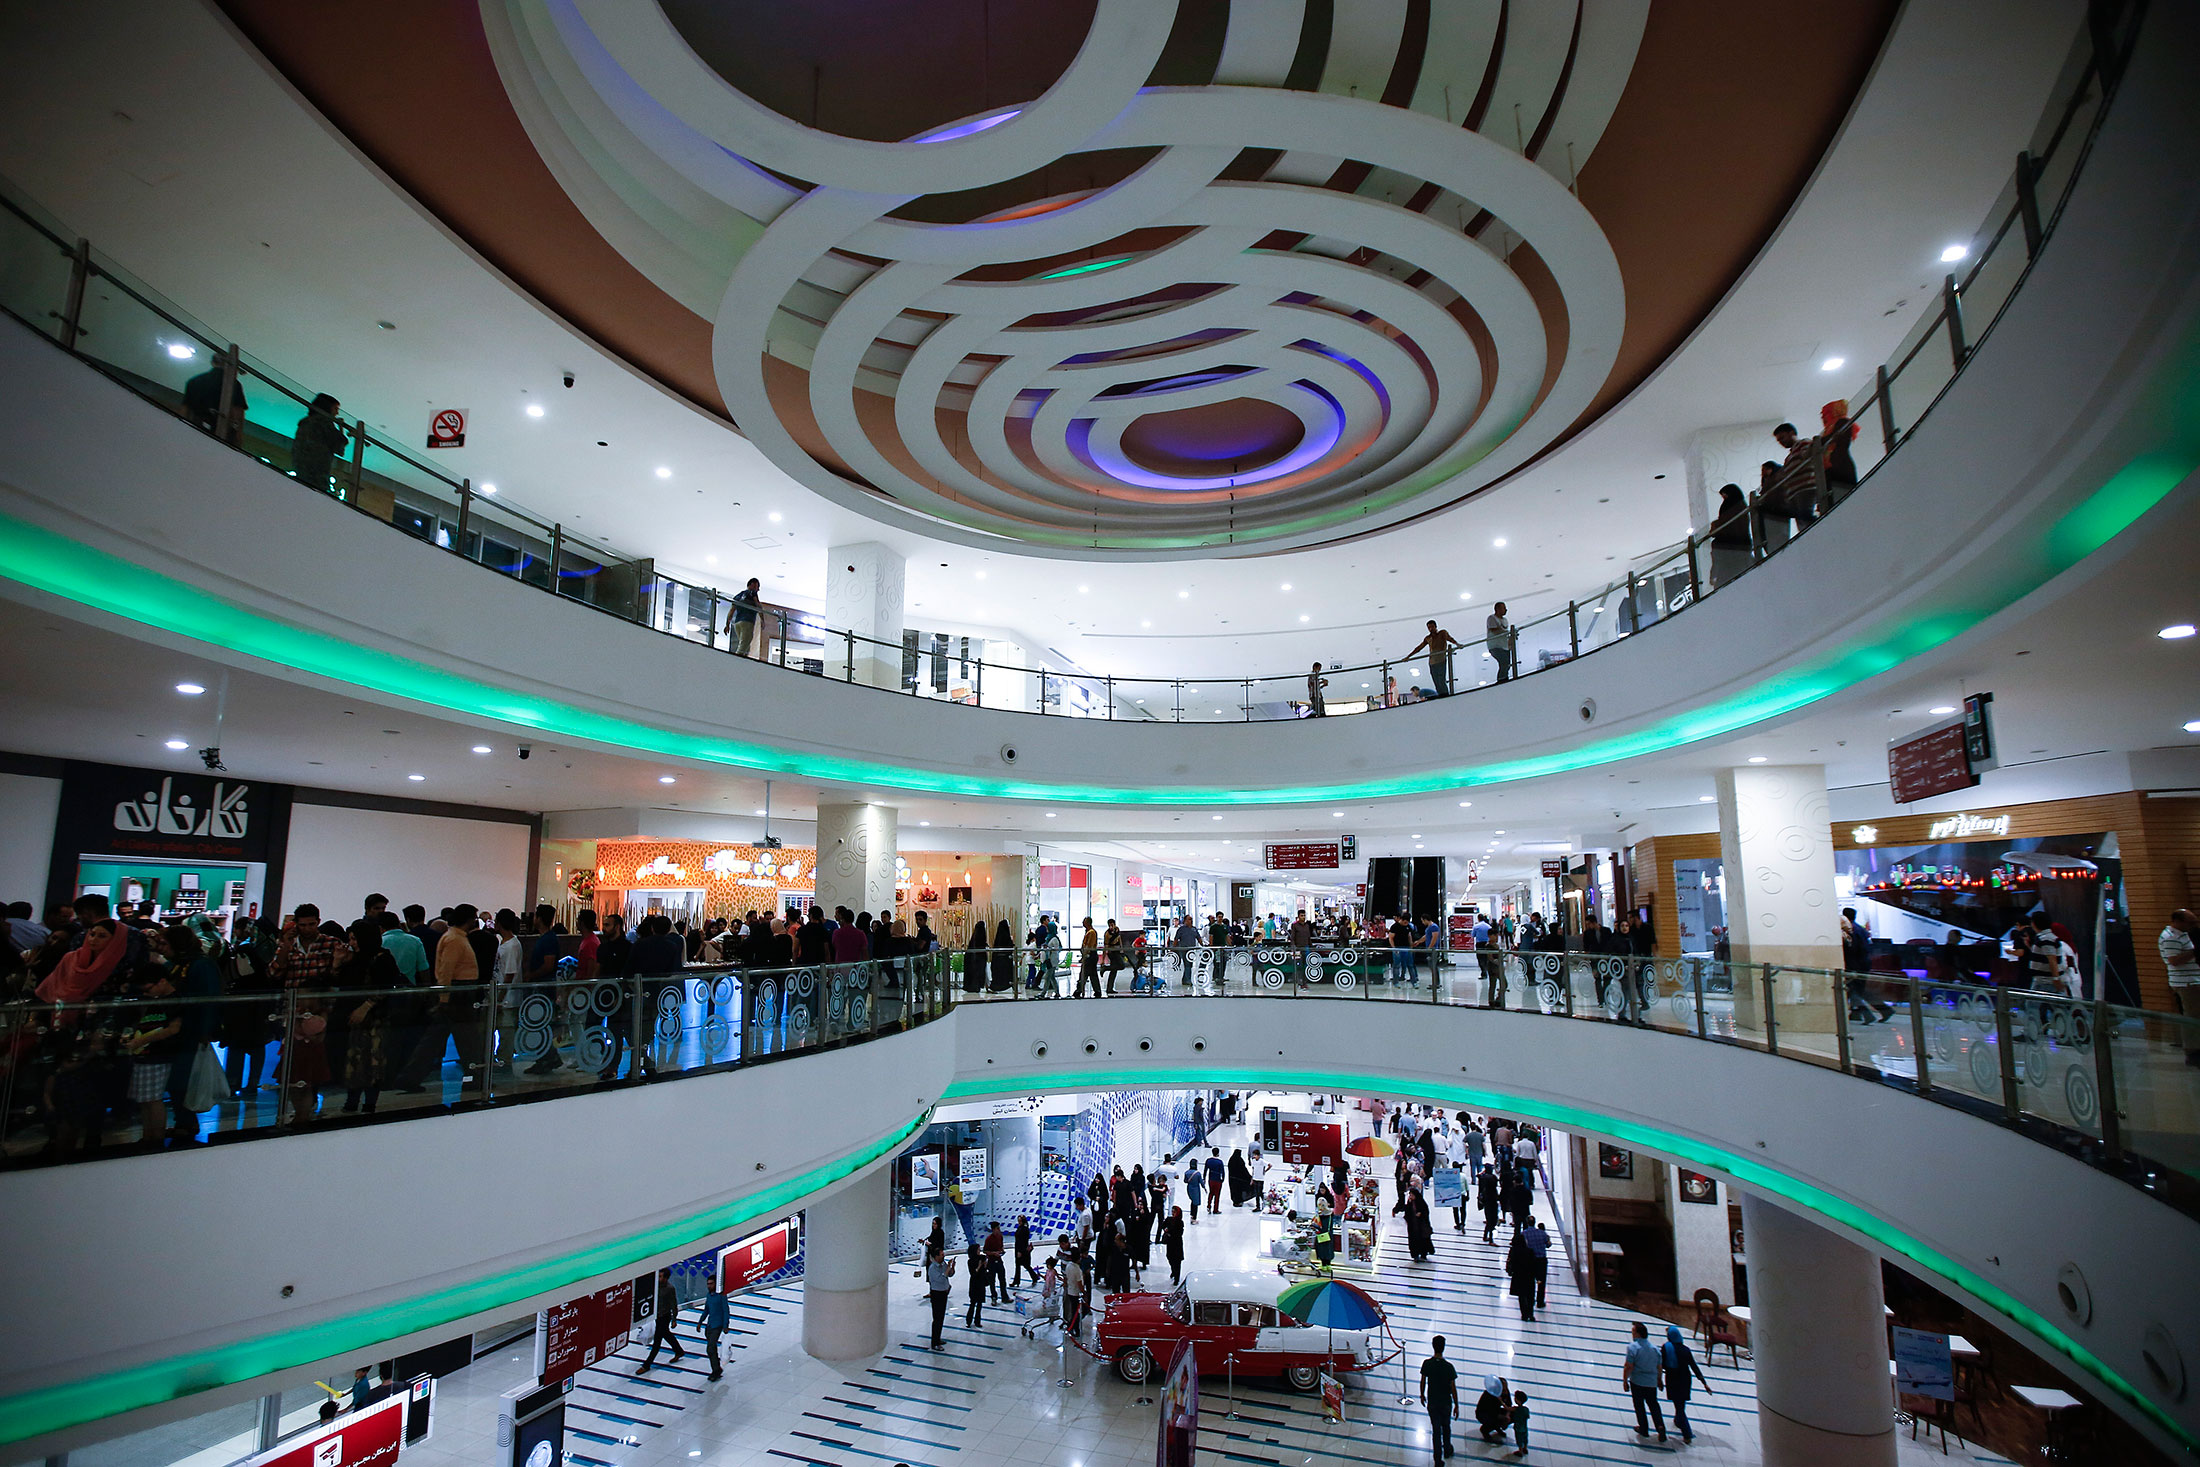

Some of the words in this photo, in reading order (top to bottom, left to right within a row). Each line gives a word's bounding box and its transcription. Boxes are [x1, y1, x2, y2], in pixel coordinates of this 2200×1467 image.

[113, 776, 249, 839] نگارخانه
[1343, 851, 1354, 859] +1
[1267, 1141, 1275, 1150] G
[640, 1301, 650, 1317] G
[371, 1446, 386, 1460] مکان
[386, 1440, 397, 1454] این
